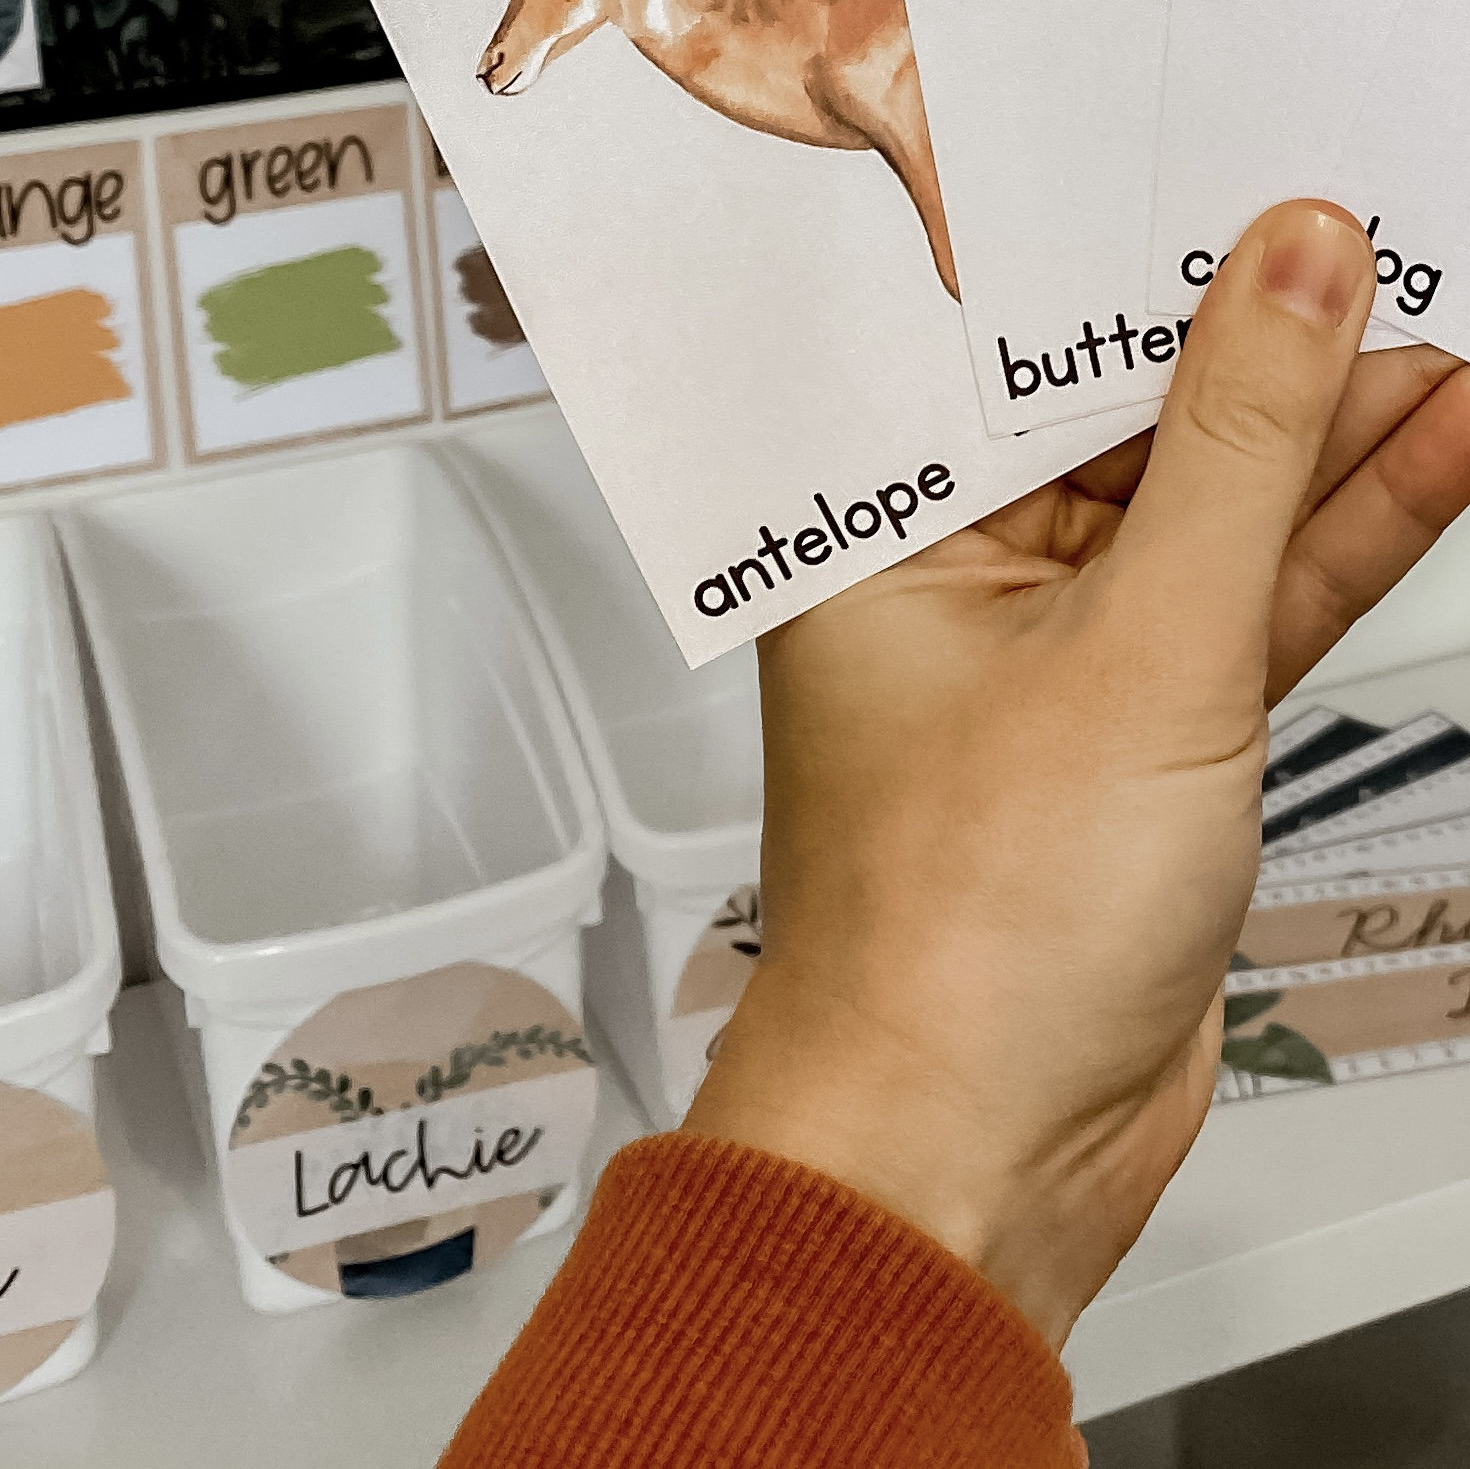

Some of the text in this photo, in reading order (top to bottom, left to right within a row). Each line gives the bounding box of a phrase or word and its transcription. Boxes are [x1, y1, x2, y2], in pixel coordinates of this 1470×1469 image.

[0, 169, 124, 246] nge
[200, 134, 374, 226] green
[998, 313, 1193, 400] butter
[693, 461, 956, 618] antelope
[294, 1119, 545, 1218] Lachie
